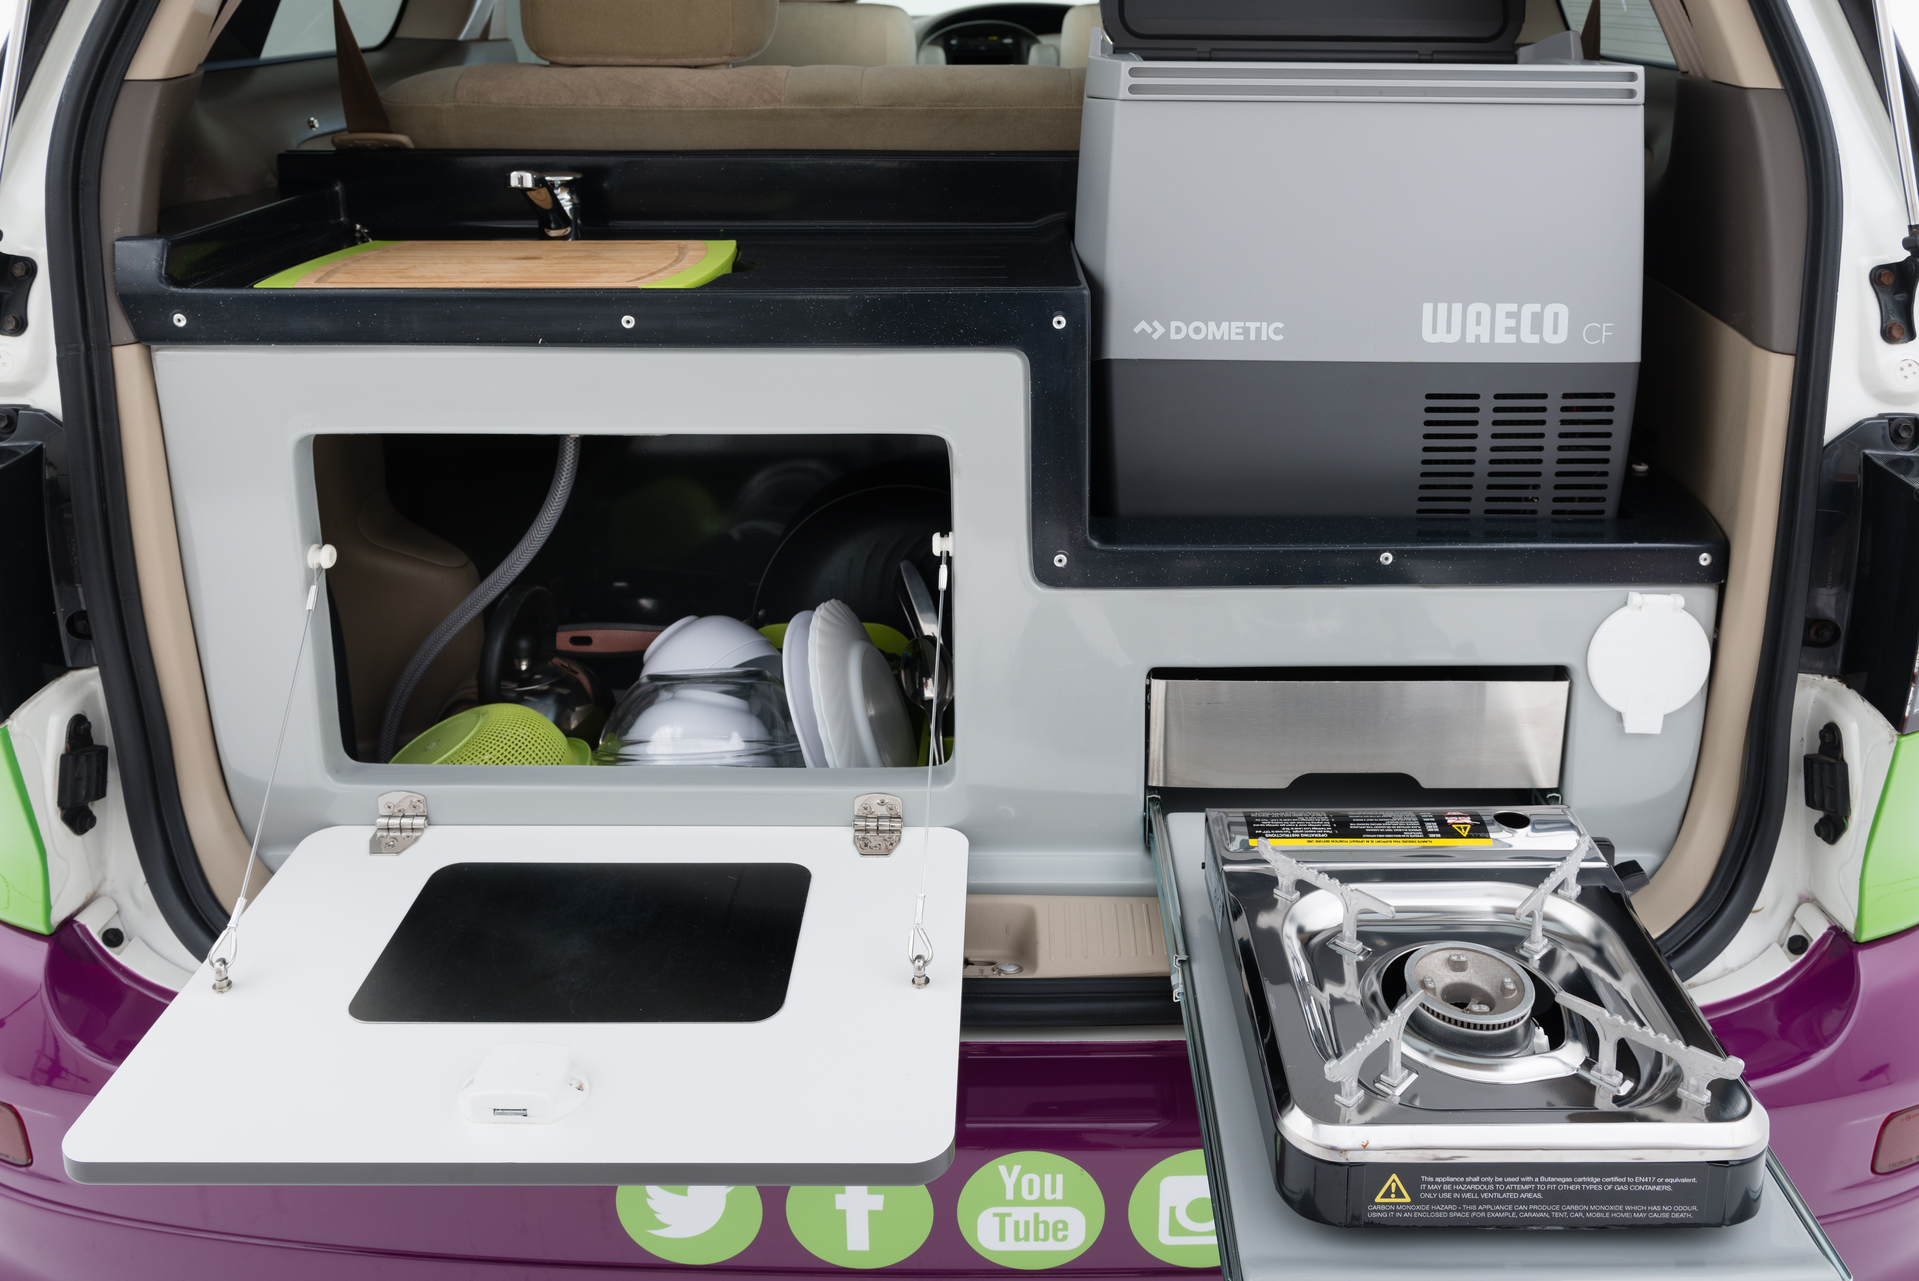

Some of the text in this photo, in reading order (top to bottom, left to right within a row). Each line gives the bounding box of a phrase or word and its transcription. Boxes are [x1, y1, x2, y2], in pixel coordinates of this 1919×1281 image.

[1170, 320, 1285, 341] DOMETIC
[1421, 302, 1614, 345] WAECO CF
[998, 1165, 1064, 1200] You
[1420, 1183, 1426, 1191] IT
[1428, 1183, 1442, 1191] MAY
[1443, 1183, 1452, 1191] BE
[1453, 1183, 1494, 1191] HAZARDOUS
[1495, 1183, 1505, 1191] TO
[1506, 1183, 1535, 1191] ATTEMPT
[1537, 1183, 1546, 1191] TO
[1558, 1183, 1580, 1191] OTHER
[1630, 1184, 1672, 1192] CONTAINERS.
[1421, 1175, 1434, 1183] This
[1435, 1175, 1464, 1183] appliance
[1465, 1175, 1480, 1183] shall
[1481, 1175, 1494, 1184] only
[1495, 1175, 1503, 1183] be
[1504, 1175, 1519, 1183] used
[1520, 1175, 1533, 1183] with
[1540, 1175, 1572, 1184] Butanegas
[1574, 1176, 1601, 1184] cartridge
[1665, 1176, 1697, 1184] equivalent.
[1471, 1211, 1485, 1219] (FOR
[1487, 1211, 1517, 1219] EXAMPLE,
[1519, 1211, 1550, 1219] CARAVAN,
[1552, 1211, 1568, 1219] TENT,
[1570, 1211, 1584, 1219] CAR,
[1611, 1211, 1632, 1219] HOME)
[992, 1212, 1069, 1243] Tube
